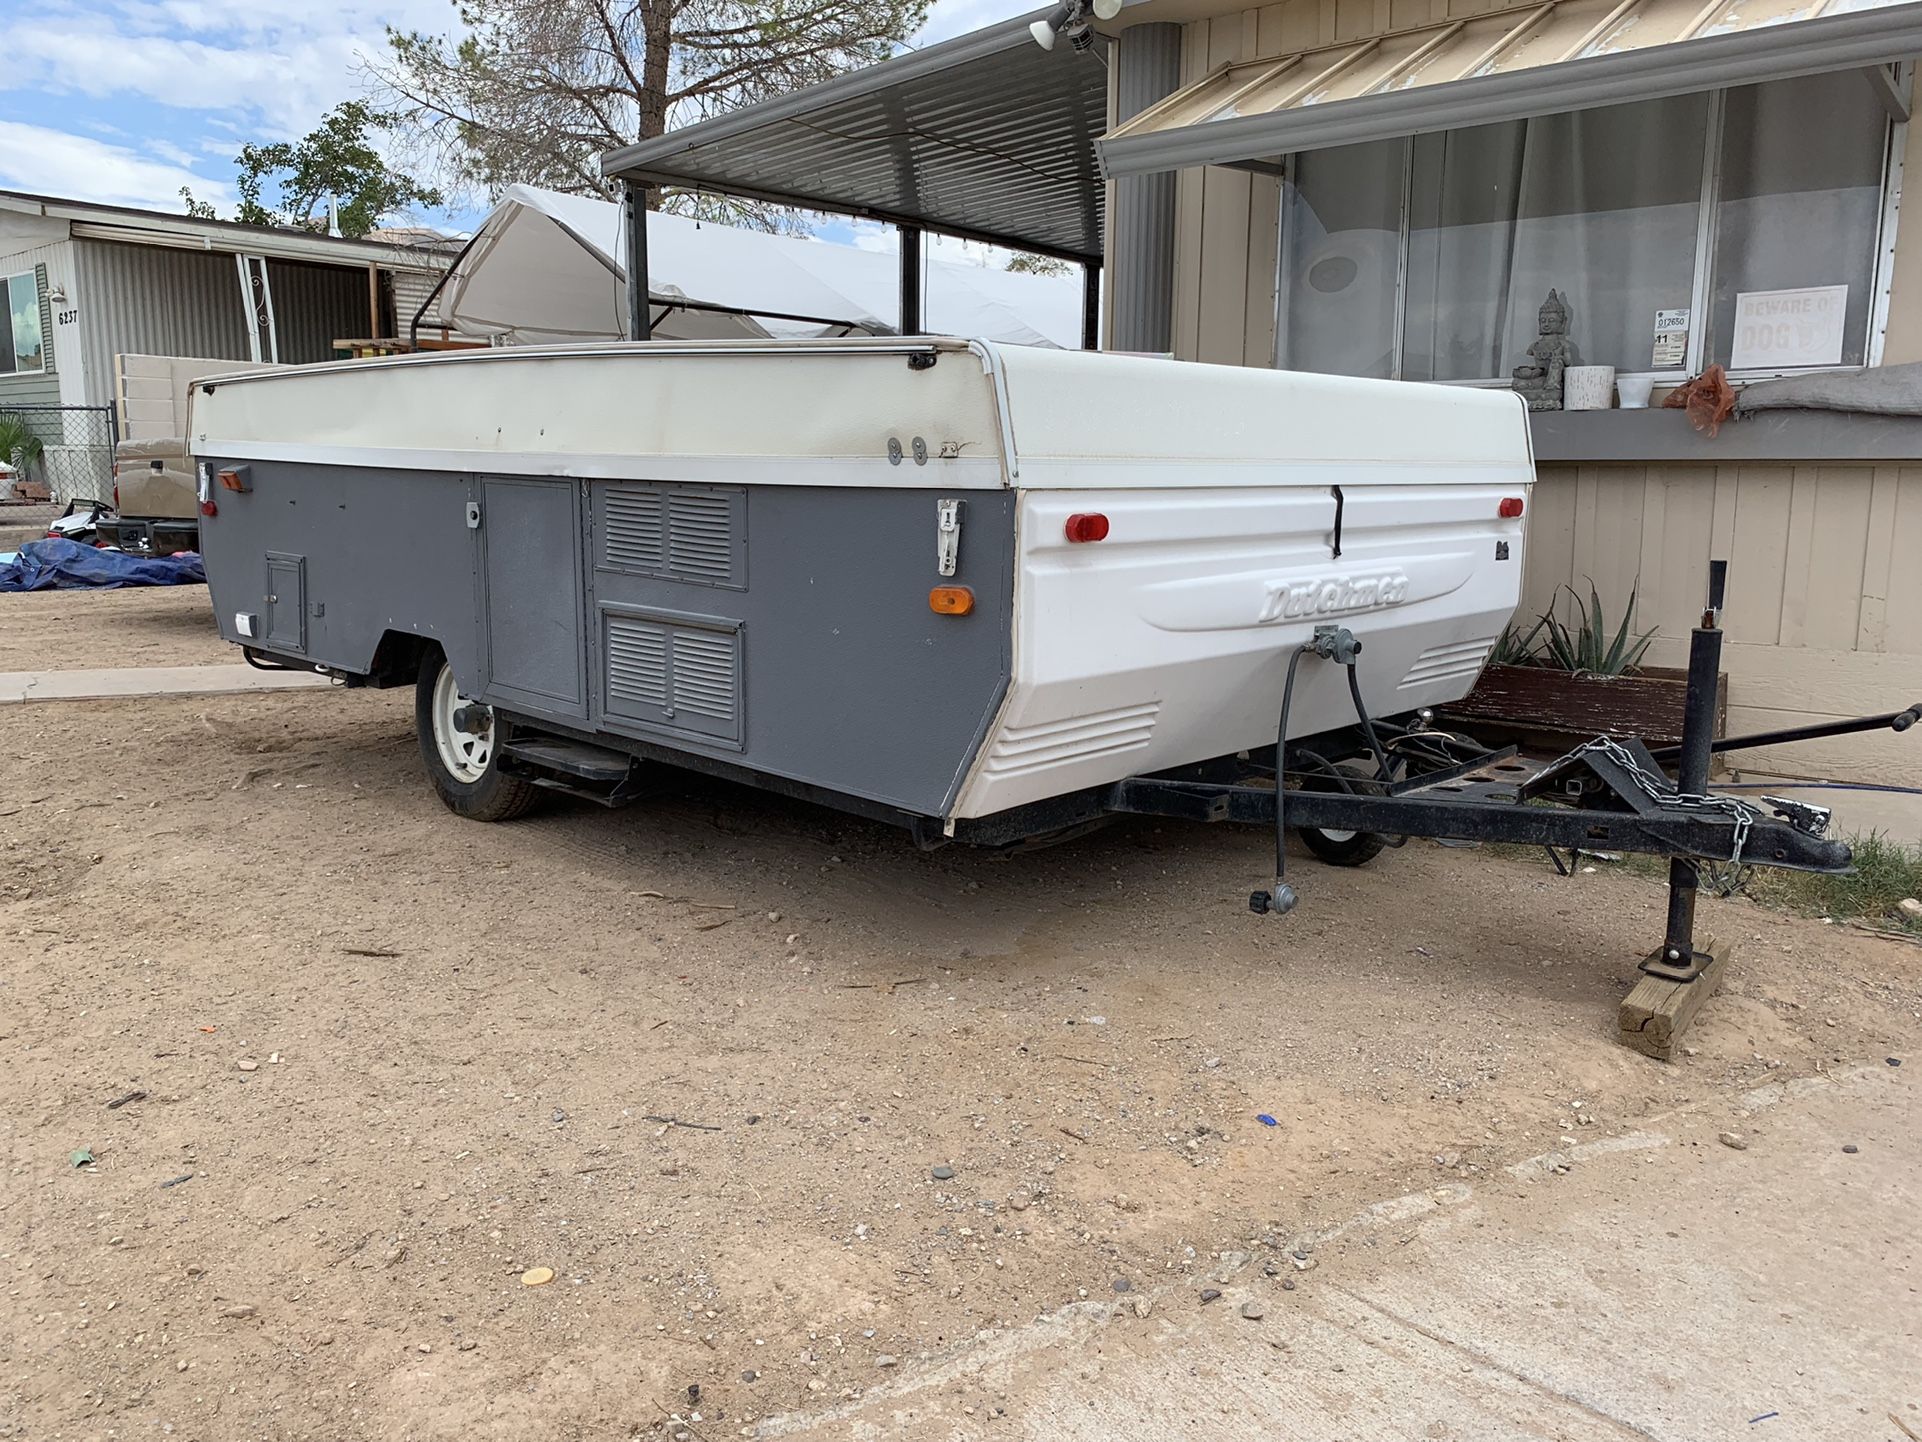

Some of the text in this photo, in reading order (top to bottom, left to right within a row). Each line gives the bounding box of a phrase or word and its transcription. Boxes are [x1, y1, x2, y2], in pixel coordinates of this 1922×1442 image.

[59, 310, 77, 325] 6237
[1743, 296, 1836, 316] BEWARE OF
[1740, 322, 1791, 351] DOG
[1258, 576, 1409, 623] Dutchmen
